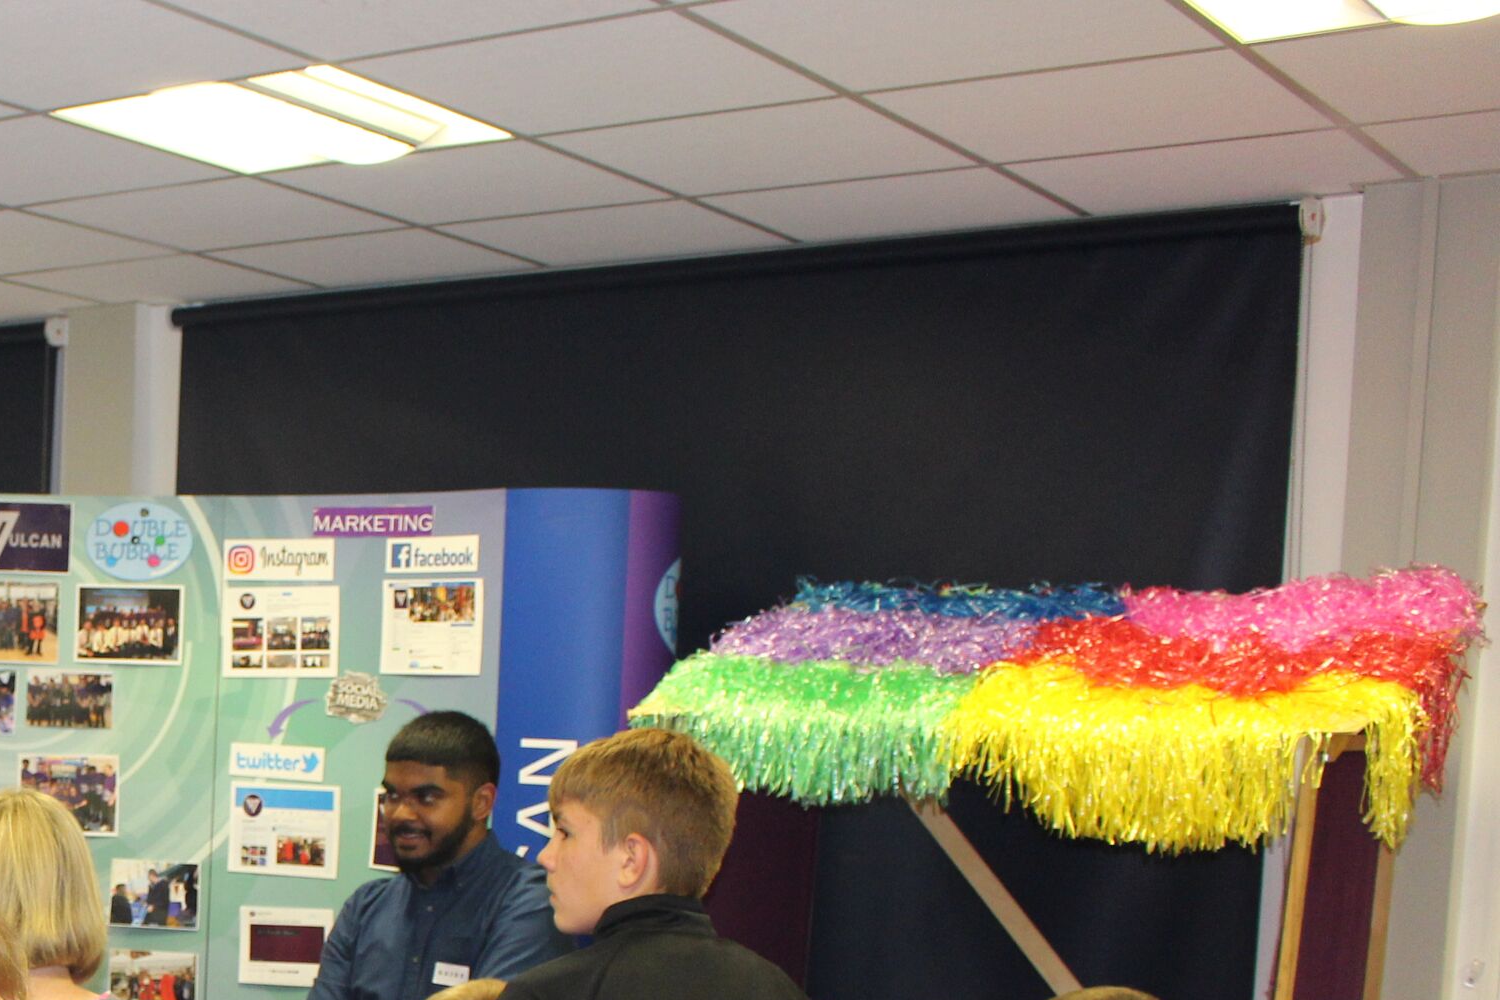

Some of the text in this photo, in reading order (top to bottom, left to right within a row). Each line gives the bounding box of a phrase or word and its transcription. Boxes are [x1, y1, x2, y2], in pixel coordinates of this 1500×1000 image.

[313, 513, 433, 533] MARKETING
[260, 545, 329, 577] Instagram
[414, 546, 474, 568] facebook
[336, 694, 379, 711] MEDIA
[236, 751, 300, 772] twitter
